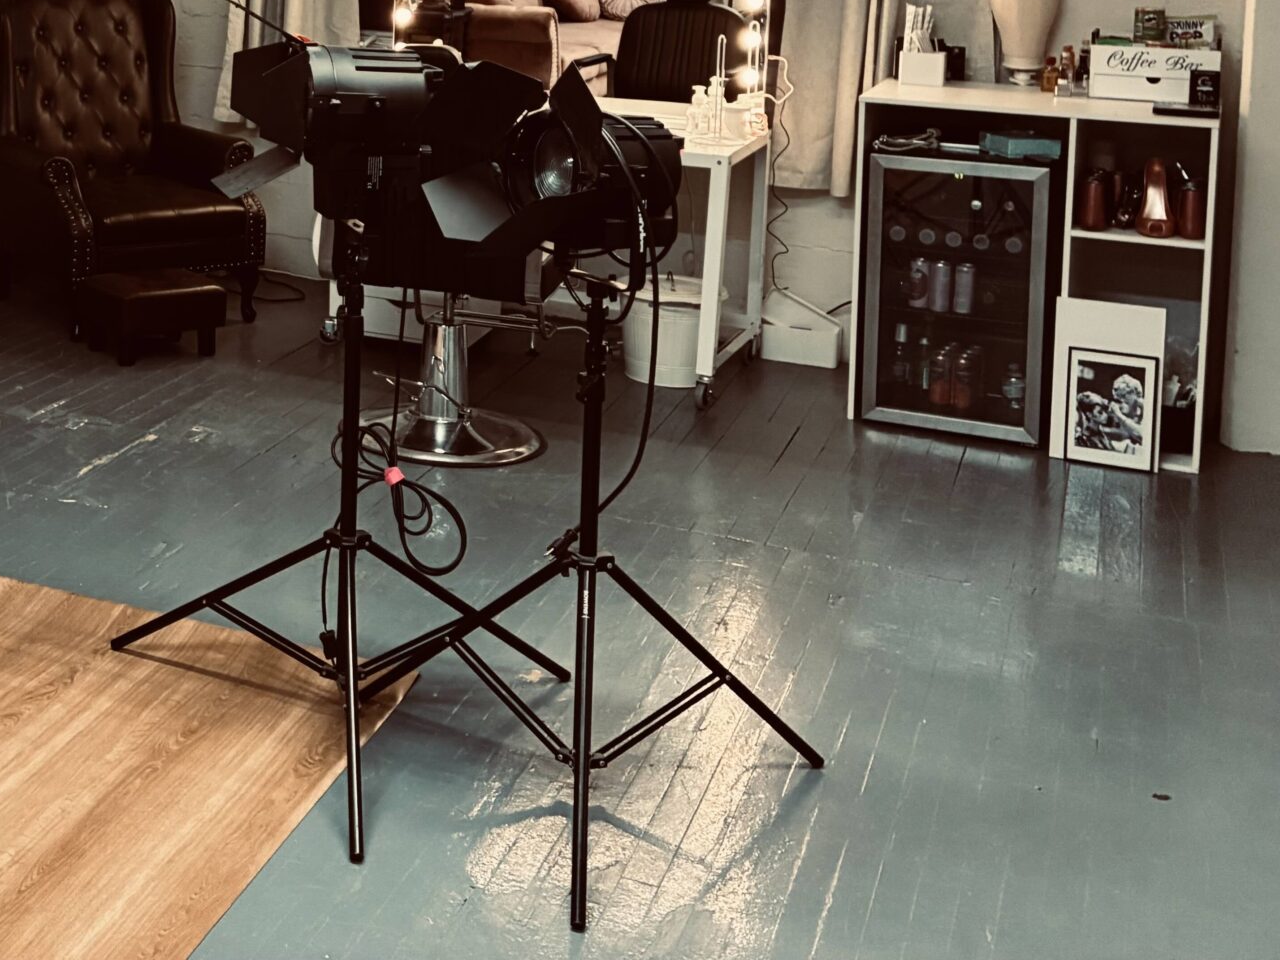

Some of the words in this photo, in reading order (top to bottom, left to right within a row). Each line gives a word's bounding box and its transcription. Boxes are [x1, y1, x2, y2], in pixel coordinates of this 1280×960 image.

[1169, 20, 1203, 30] SKINNY
[1106, 50, 1157, 72] Coffee
[1165, 54, 1203, 71] Bar
